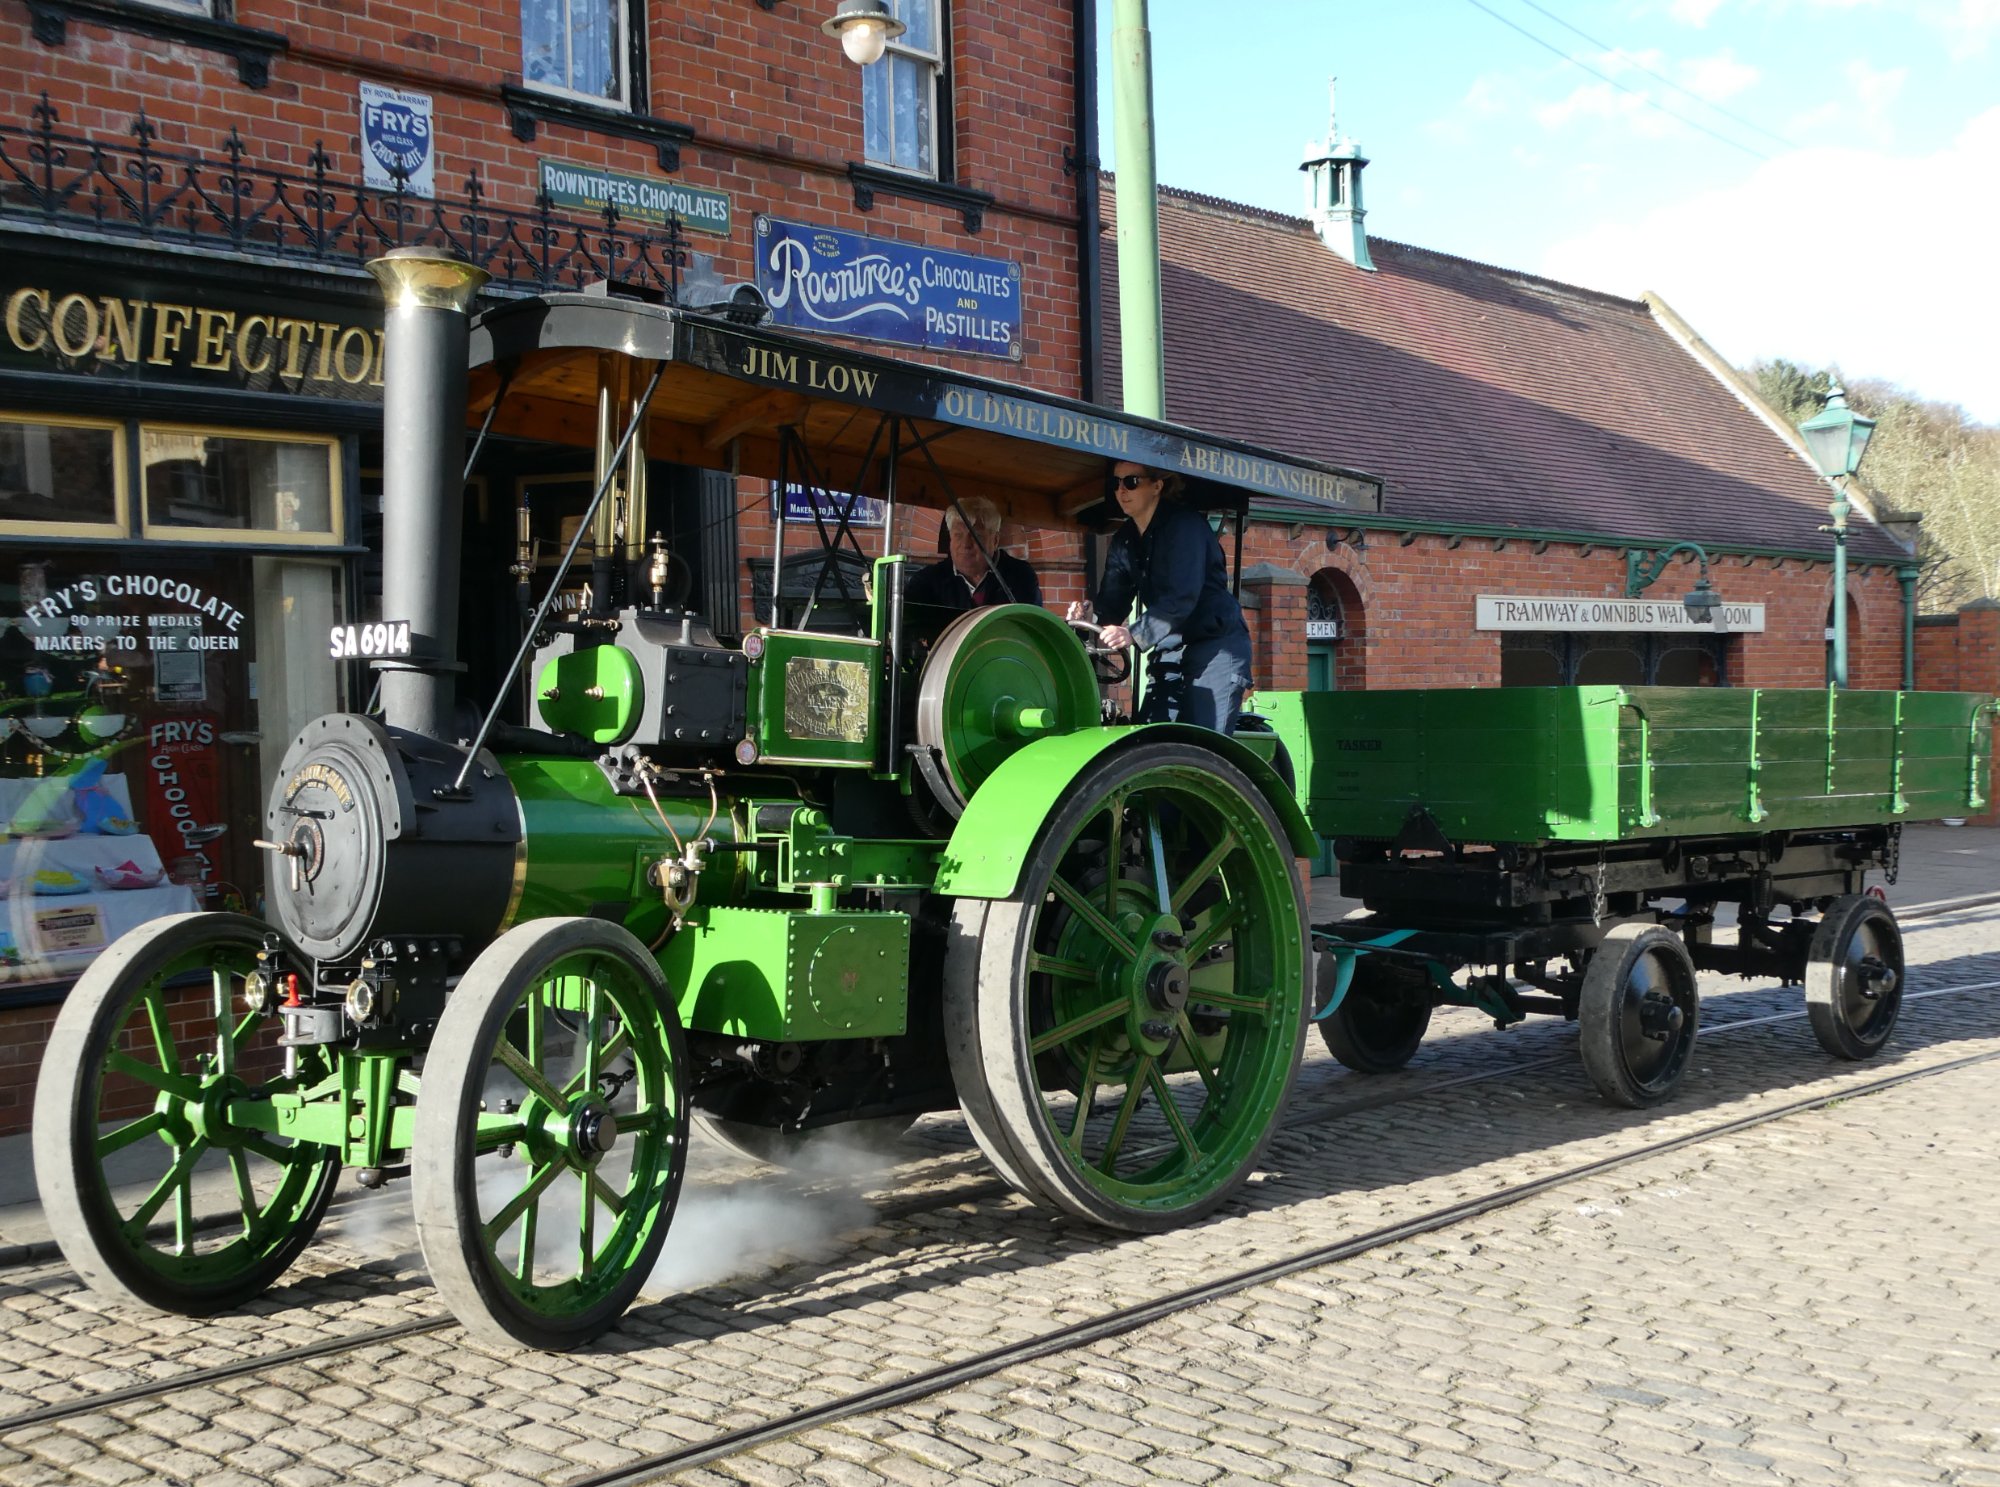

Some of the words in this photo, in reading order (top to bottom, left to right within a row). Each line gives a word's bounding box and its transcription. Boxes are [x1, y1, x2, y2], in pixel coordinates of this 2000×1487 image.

[362, 86, 372, 96] BY
[374, 89, 396, 101] ROYAL
[397, 93, 429, 107] WARRANT
[367, 106, 427, 137] FRY'S
[370, 139, 426, 169] CHOCLATE
[544, 165, 637, 206] ROWNTREE'S
[639, 183, 728, 222] CHOCOLATES
[620, 205, 629, 213] TO
[651, 210, 665, 219] THE
[669, 213, 688, 223] ING
[767, 236, 922, 323] Rowntree's
[922, 256, 1011, 299] CHOCOLATES
[956, 297, 978, 310] AND
[925, 306, 1011, 344] PASTILLES
[742, 346, 800, 384] JIM
[807, 358, 879, 399] LOW
[944, 390, 1129, 454] OLDMELDRUM
[1179, 445, 1348, 504] ABERDEENSHIRE
[790, 503, 814, 515] MAKER
[818, 507, 827, 515] TO
[25, 580, 97, 627] FRY'S
[106, 575, 245, 632] CHOCOLATE
[1495, 602, 1579, 623] TRAMWAY
[1581, 609, 1589, 623] &
[1592, 604, 1653, 624] OMNIBUS
[1723, 606, 1752, 625] OOM
[71, 615, 89, 627] 90
[97, 615, 141, 627] PRIZE
[148, 615, 203, 627] MEDALS
[34, 636, 105, 651] MAKERS
[116, 636, 137, 650] TO
[147, 636, 177, 650] THE
[188, 636, 239, 651] QUEEN
[330, 626, 357, 658] SA
[361, 623, 409, 655] 6914
[151, 719, 214, 748] FRY'S
[151, 755, 219, 897] CHOCOLATE
